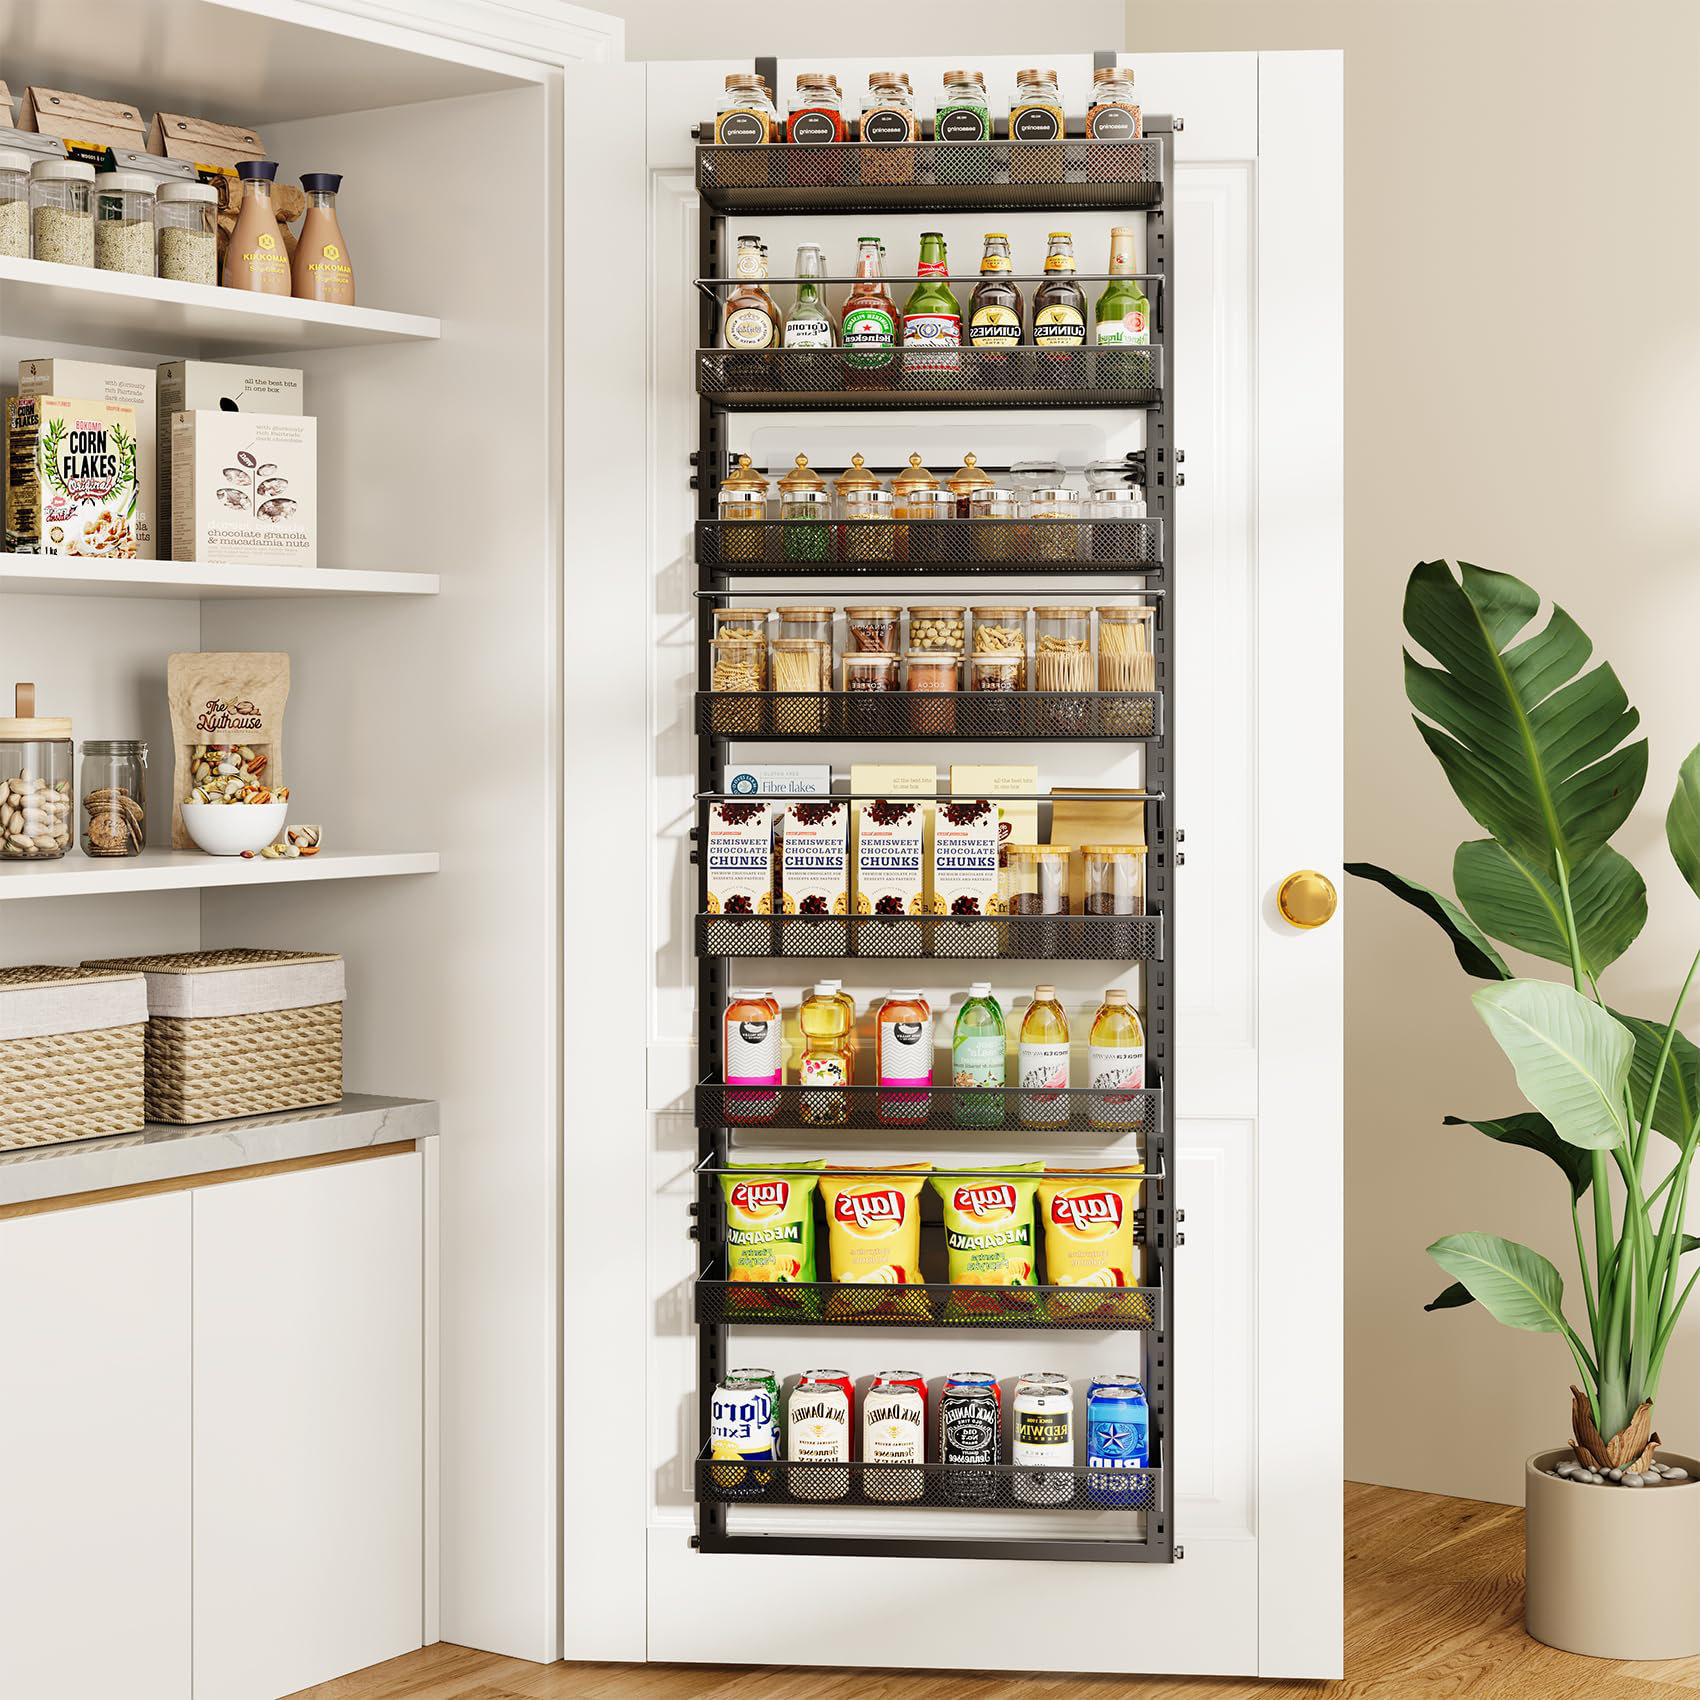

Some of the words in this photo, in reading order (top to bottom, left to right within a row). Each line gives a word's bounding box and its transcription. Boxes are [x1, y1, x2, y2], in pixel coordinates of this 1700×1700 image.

[17, 405, 35, 417] CORN
[15, 414, 39, 429] FLAKES
[76, 421, 102, 431] BOKOMO
[69, 431, 108, 455] CORN
[63, 455, 116, 479] FLAKES
[67, 478, 113, 496] Original
[136, 532, 151, 542] uts
[208, 529, 262, 539] chocolate
[264, 531, 307, 541] granola
[208, 537, 218, 545] &
[219, 537, 283, 546] macadamia
[285, 540, 310, 548] nuts
[49, 547, 58, 556] kg
[206, 699, 227, 715] The
[762, 780, 787, 793] Fibre
[789, 780, 816, 793] flakes
[710, 856, 768, 866] CHUNKS
[785, 856, 843, 866] CHUNKS
[860, 856, 919, 867] CHUNKS
[936, 857, 995, 867] CHUNKS
